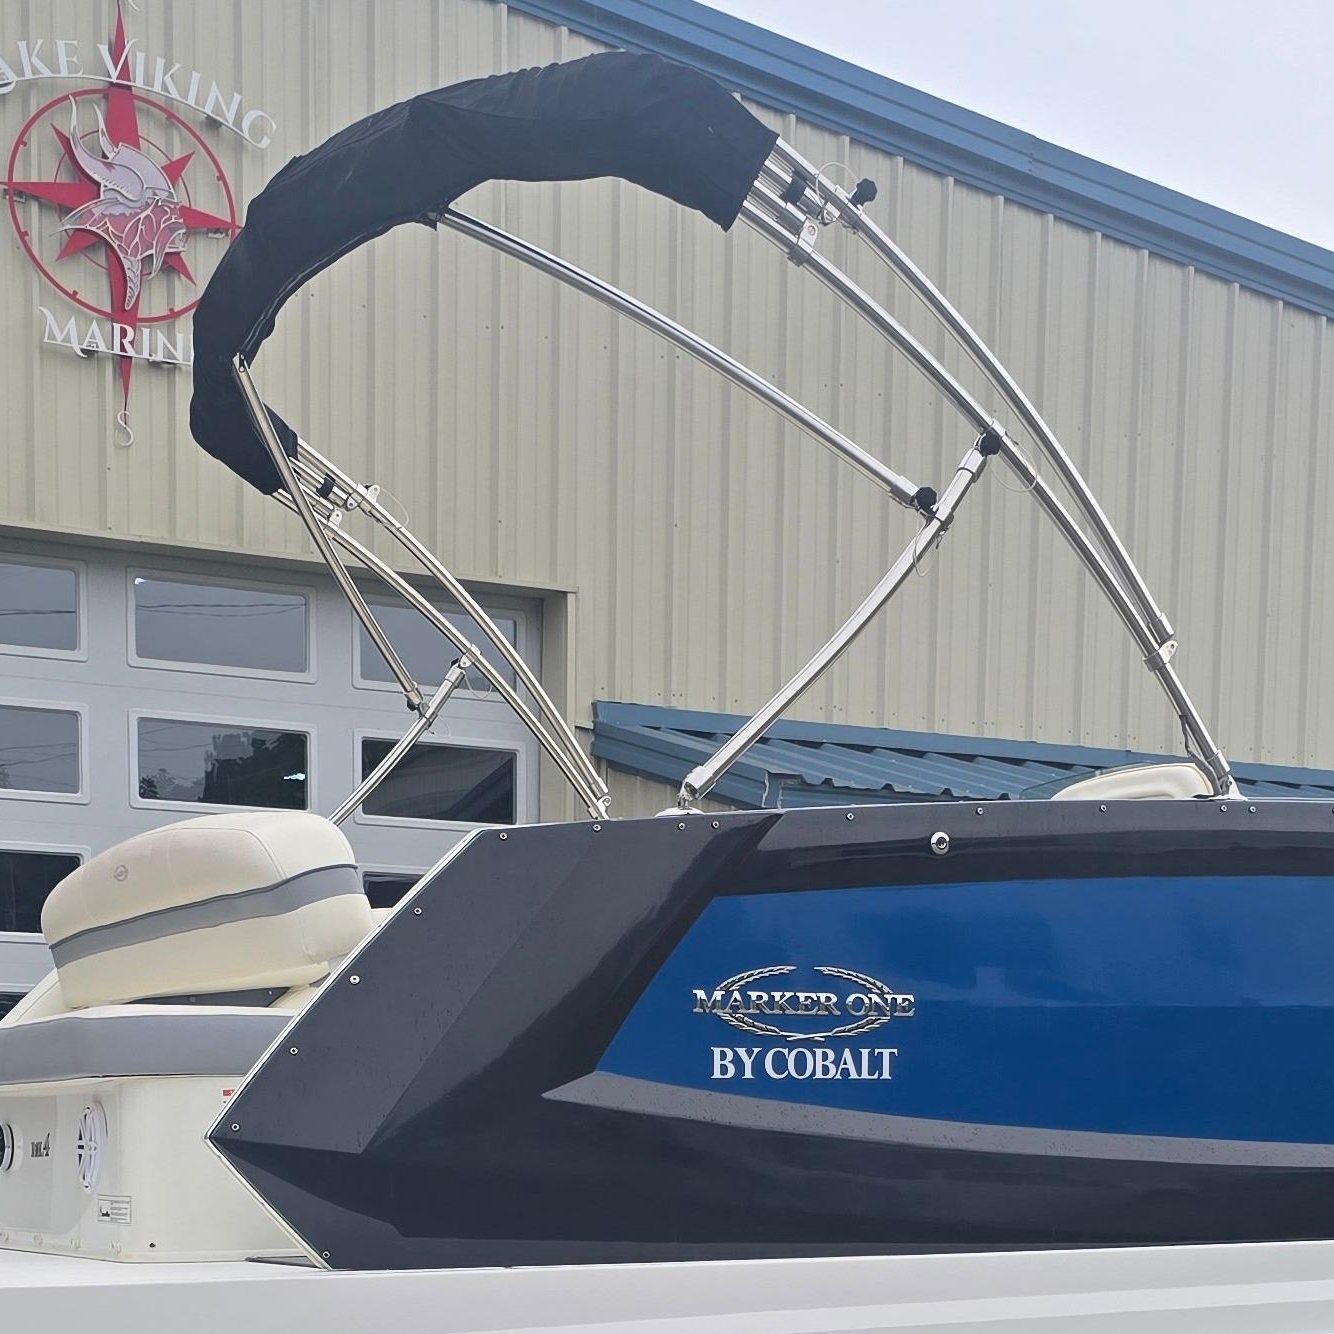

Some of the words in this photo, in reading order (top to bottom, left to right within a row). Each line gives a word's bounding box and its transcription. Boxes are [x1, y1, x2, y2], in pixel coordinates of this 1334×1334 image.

[97, 38, 277, 149] VIKING
[38, 306, 193, 367] MARIN
[115, 410, 134, 447] S
[692, 989, 841, 1016] MARKER
[846, 993, 916, 1017] ONE
[710, 1046, 762, 1080] BY
[764, 1047, 898, 1080] COBALT
